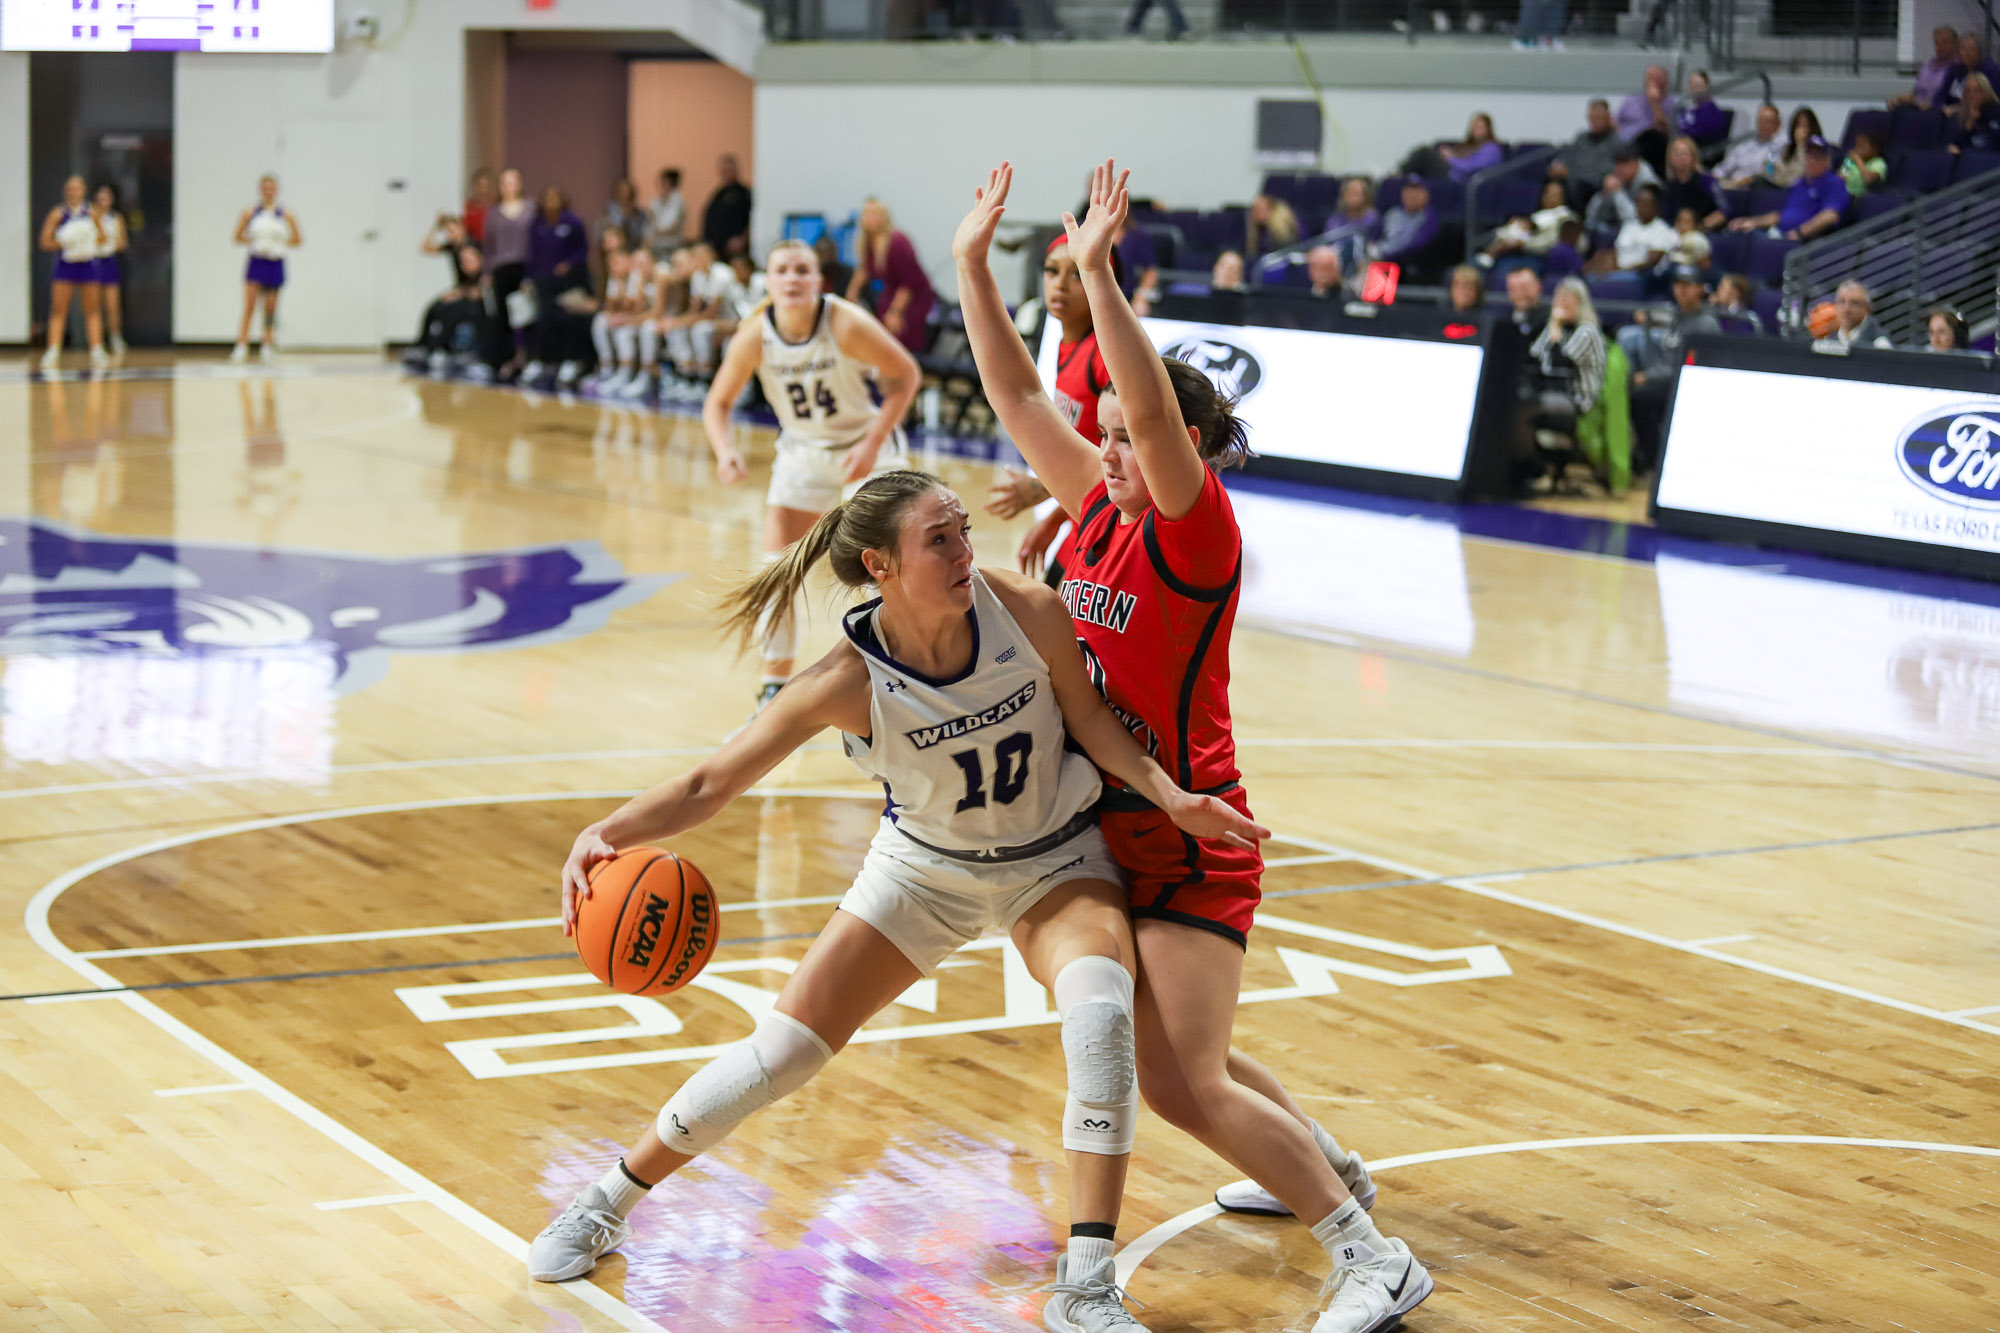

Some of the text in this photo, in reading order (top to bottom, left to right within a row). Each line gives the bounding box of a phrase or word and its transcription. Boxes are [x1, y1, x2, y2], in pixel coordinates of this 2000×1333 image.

[787, 379, 838, 418] 24
[1946, 516, 1989, 539] FORD
[995, 646, 1017, 665] WAC
[906, 680, 1036, 750] WILDCATS
[951, 730, 1033, 815] 10
[627, 892, 669, 968] NCAA
[661, 893, 710, 987] Wilson
